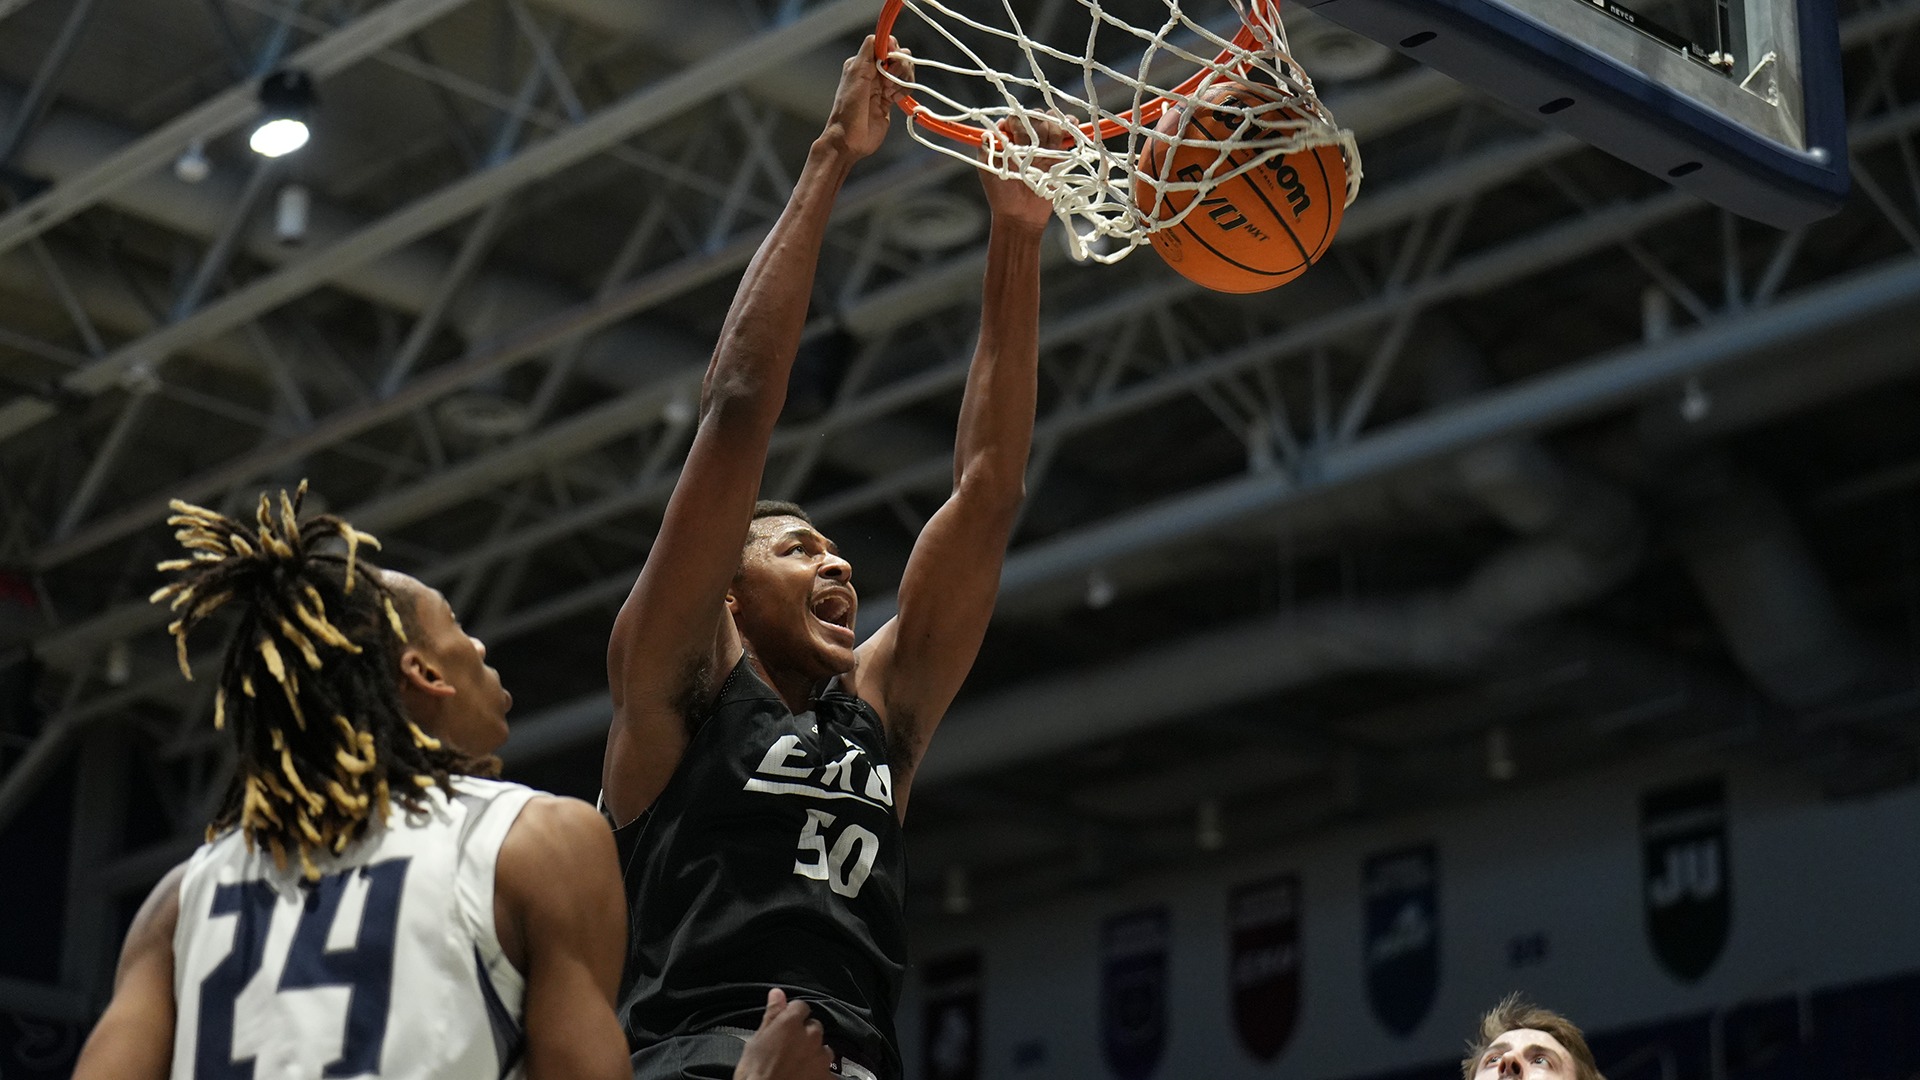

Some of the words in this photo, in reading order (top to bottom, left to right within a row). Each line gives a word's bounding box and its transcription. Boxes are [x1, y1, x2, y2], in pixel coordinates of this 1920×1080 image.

[1244, 223, 1270, 243] NXT
[793, 808, 879, 899] 50
[1650, 837, 1720, 908] JU
[193, 856, 413, 1080] 24
